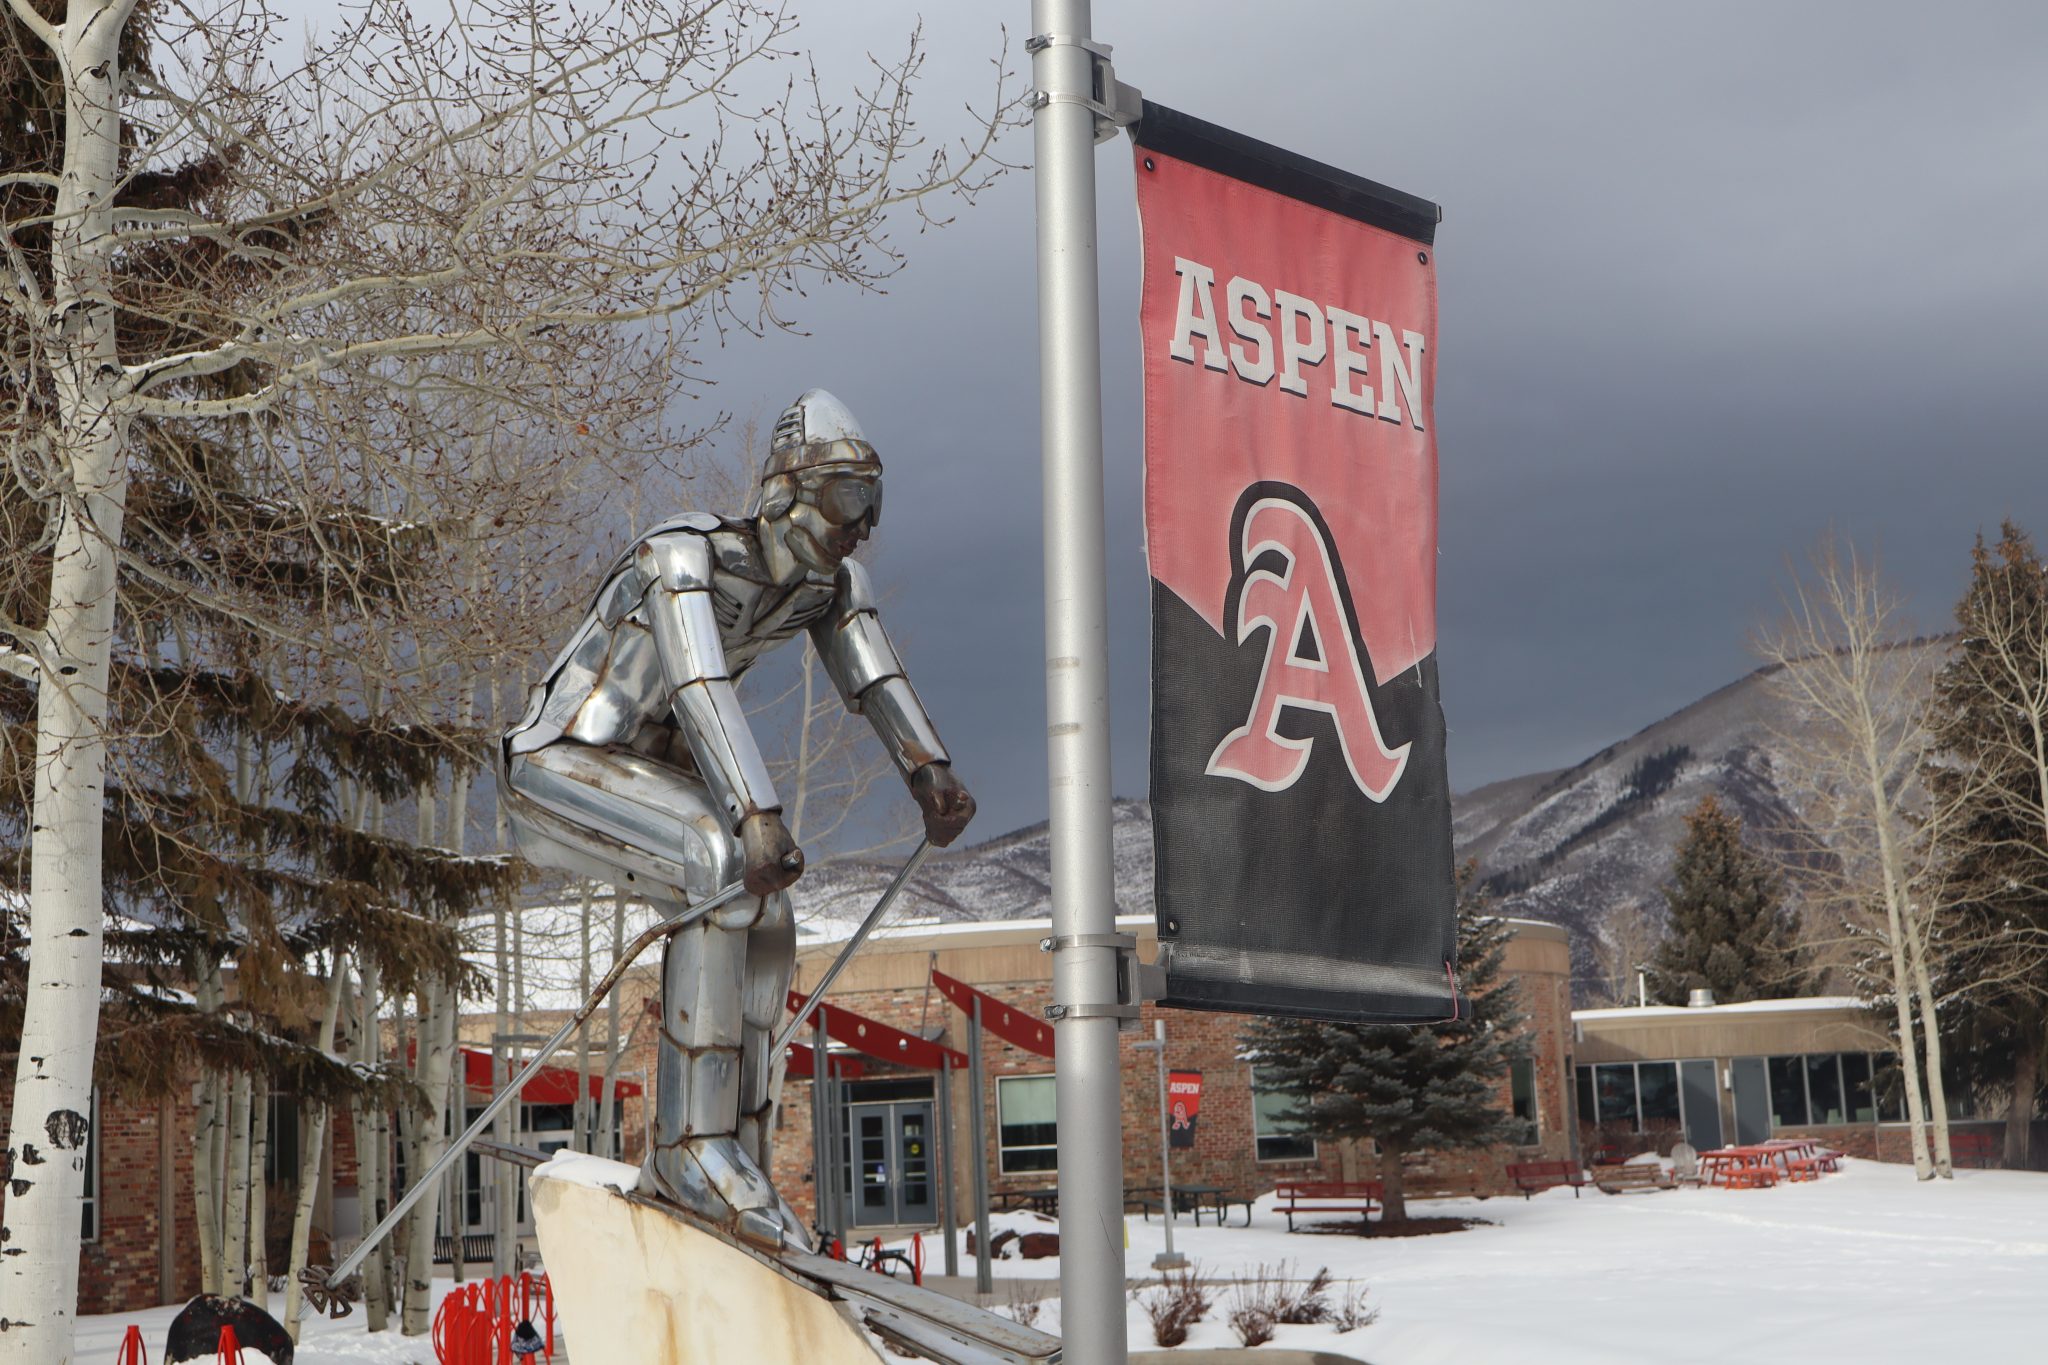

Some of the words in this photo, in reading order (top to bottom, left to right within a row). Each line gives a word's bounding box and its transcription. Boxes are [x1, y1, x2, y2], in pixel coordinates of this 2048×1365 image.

[1169, 256, 1425, 432] ASPEN
[1204, 480, 1412, 803] A
[1169, 1082, 1200, 1094] ASPEN
